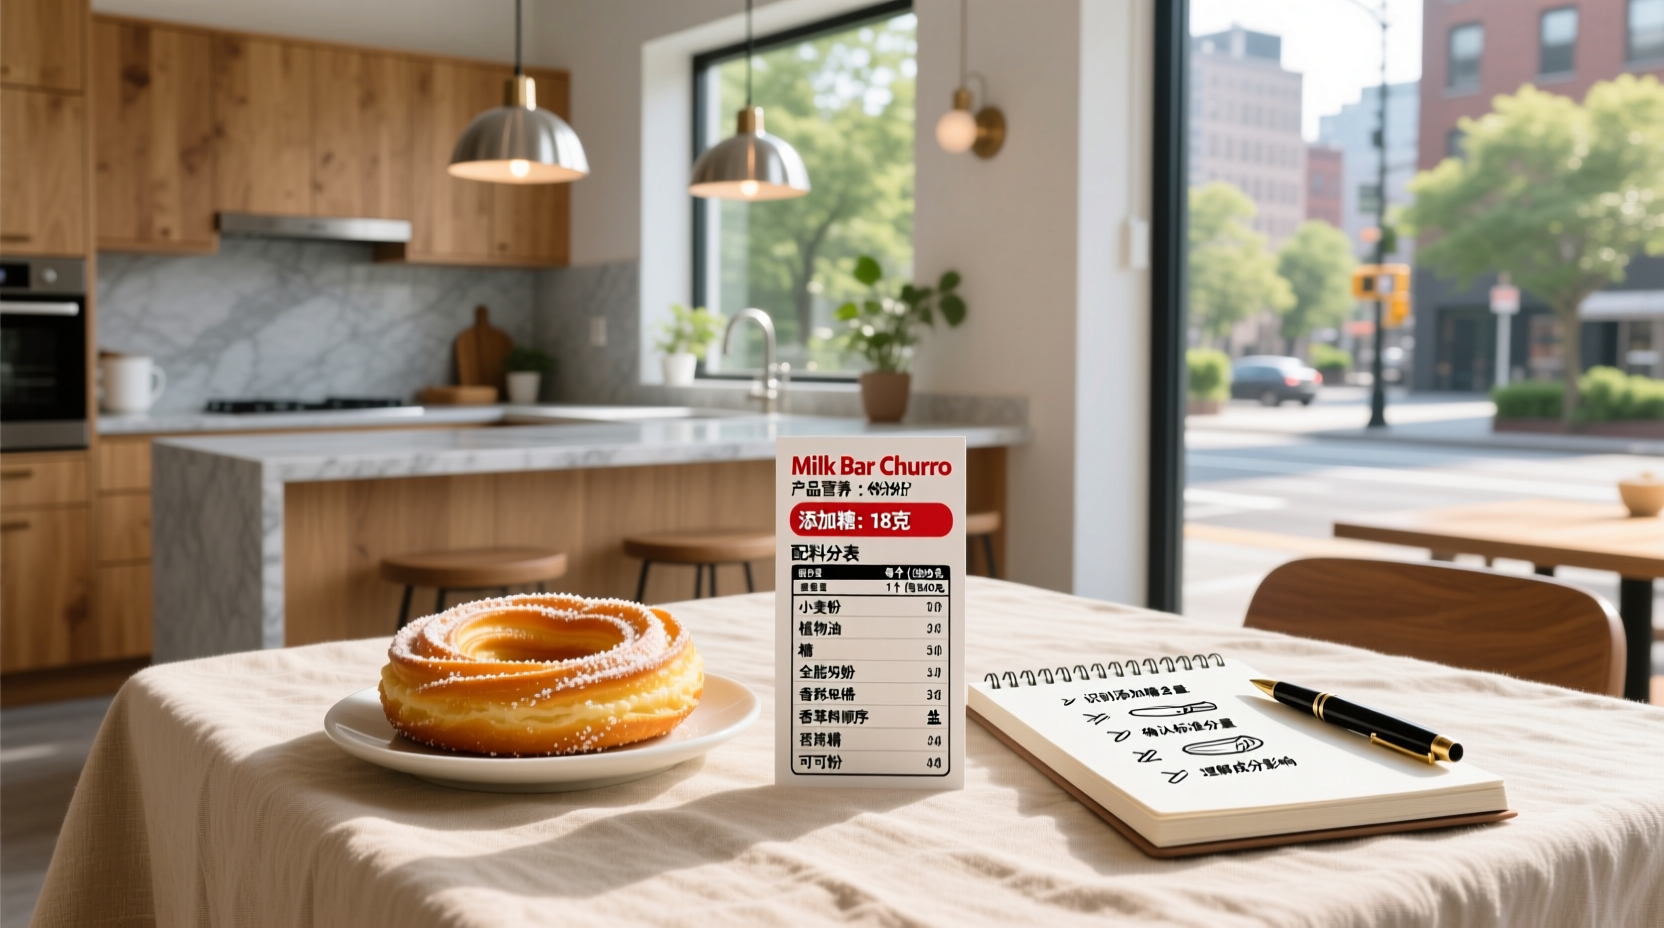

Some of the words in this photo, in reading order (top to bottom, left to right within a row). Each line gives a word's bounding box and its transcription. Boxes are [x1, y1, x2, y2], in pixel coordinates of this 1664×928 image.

[791, 455, 836, 476] Milk
[840, 456, 876, 476] Bar
[879, 455, 952, 476] Churro
[791, 544, 860, 562] 配料分表
[799, 600, 841, 615] 小麦粉
[799, 620, 842, 637] 植物油
[799, 754, 843, 770] 可可粉
